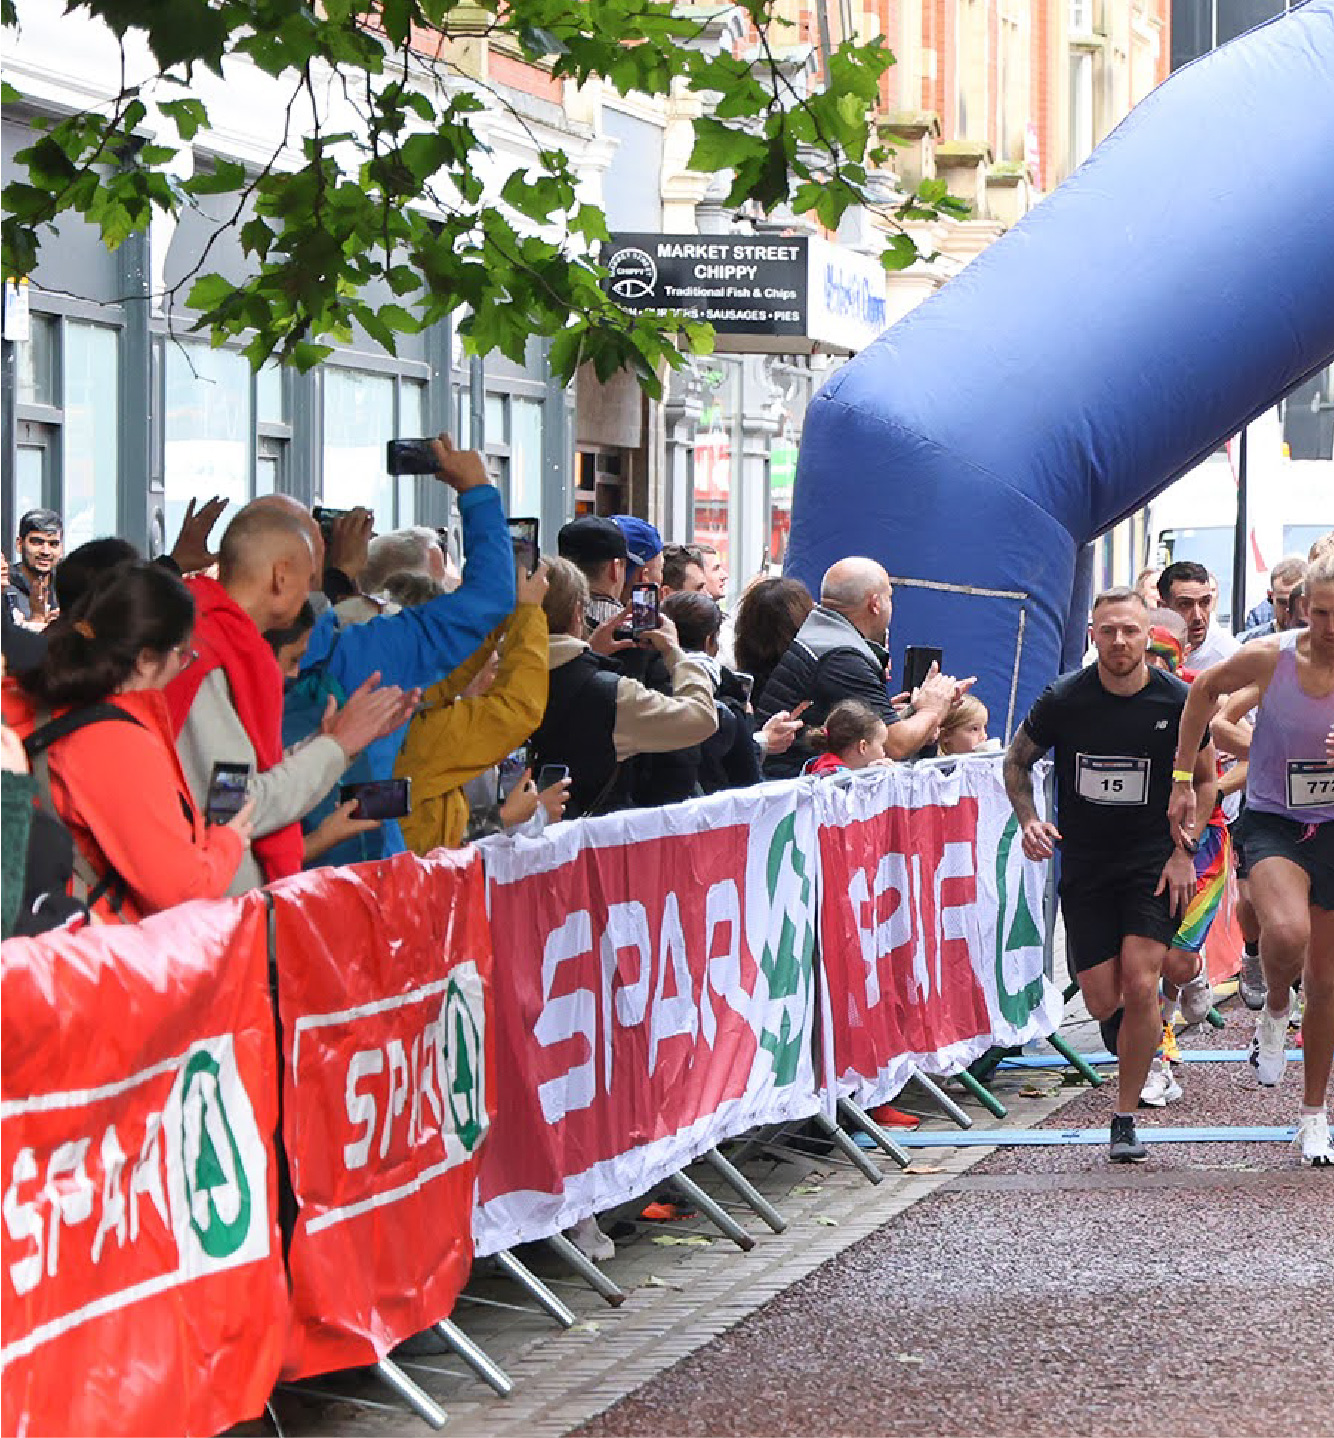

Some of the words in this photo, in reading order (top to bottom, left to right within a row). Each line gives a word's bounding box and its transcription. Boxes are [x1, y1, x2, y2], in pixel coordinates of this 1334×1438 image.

[657, 243, 729, 260] MARKET
[733, 245, 800, 261] STREET
[694, 264, 758, 281] CHIPPY
[664, 285, 725, 298] Traditional
[726, 286, 751, 298] Fish
[753, 287, 763, 298] &
[764, 287, 797, 300] Chips
[706, 309, 767, 321] SAUSAGES
[774, 310, 800, 321] PIES
[1101, 779, 1124, 793] 15
[533, 878, 751, 1125] SPAR
[2, 1111, 174, 1296] SPAR
